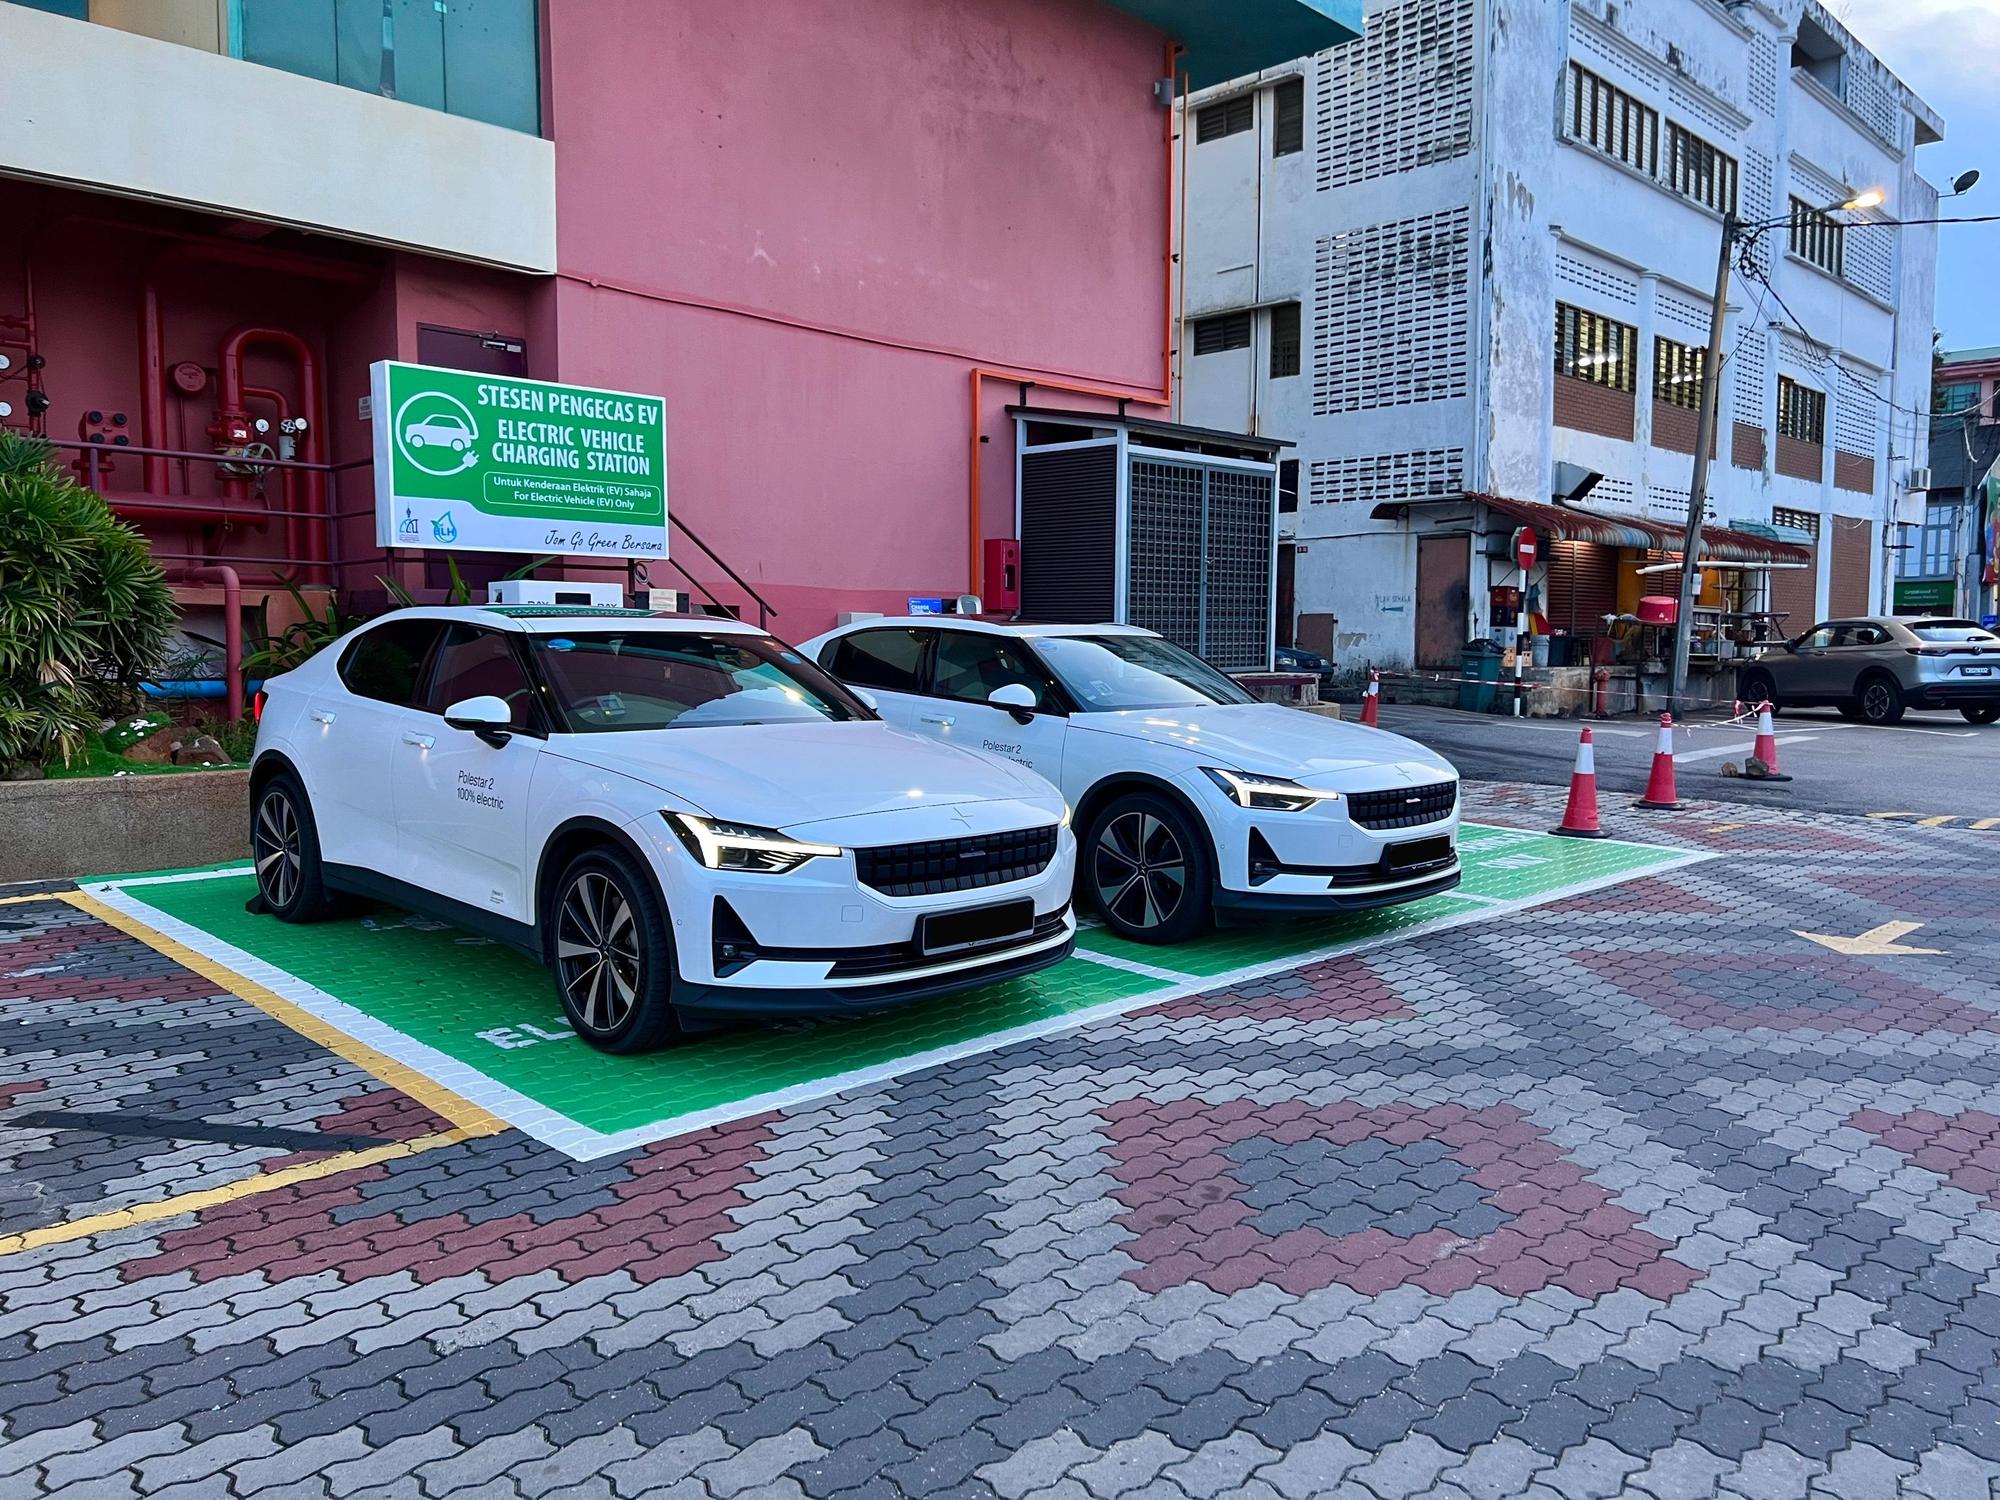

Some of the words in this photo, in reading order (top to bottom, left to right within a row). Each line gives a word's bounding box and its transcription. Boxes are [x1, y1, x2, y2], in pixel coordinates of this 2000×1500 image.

[477, 384, 544, 412] STESEN
[548, 392, 635, 423] PENGECAS
[638, 404, 658, 426] EV
[498, 418, 575, 446] ELECTRIC
[580, 427, 645, 454] VEHICLE
[491, 441, 580, 469] CHARGING
[586, 451, 650, 476] STATION
[493, 476, 522, 487] Untuk
[523, 479, 571, 492] Kenderaan
[572, 482, 605, 494] Elektrik
[606, 485, 624, 496] (EV)
[624, 487, 652, 500] Sahaja
[514, 490, 530, 501] For
[530, 492, 563, 504] Electric
[563, 494, 596, 506] Vehicle
[596, 496, 614, 508] (EV)
[615, 499, 635, 511] Only
[433, 527, 457, 537] BLH
[545, 529, 566, 545] Jom
[570, 531, 584, 551] Go
[588, 532, 618, 552] Green
[622, 534, 662, 551] Bersama
[982, 739, 1015, 754] Polestar
[1015, 744, 1022, 755] 2
[457, 769, 488, 789] Polestar
[488, 777, 495, 790] 2
[456, 787, 476, 803] 100%
[476, 792, 504, 810] electric
